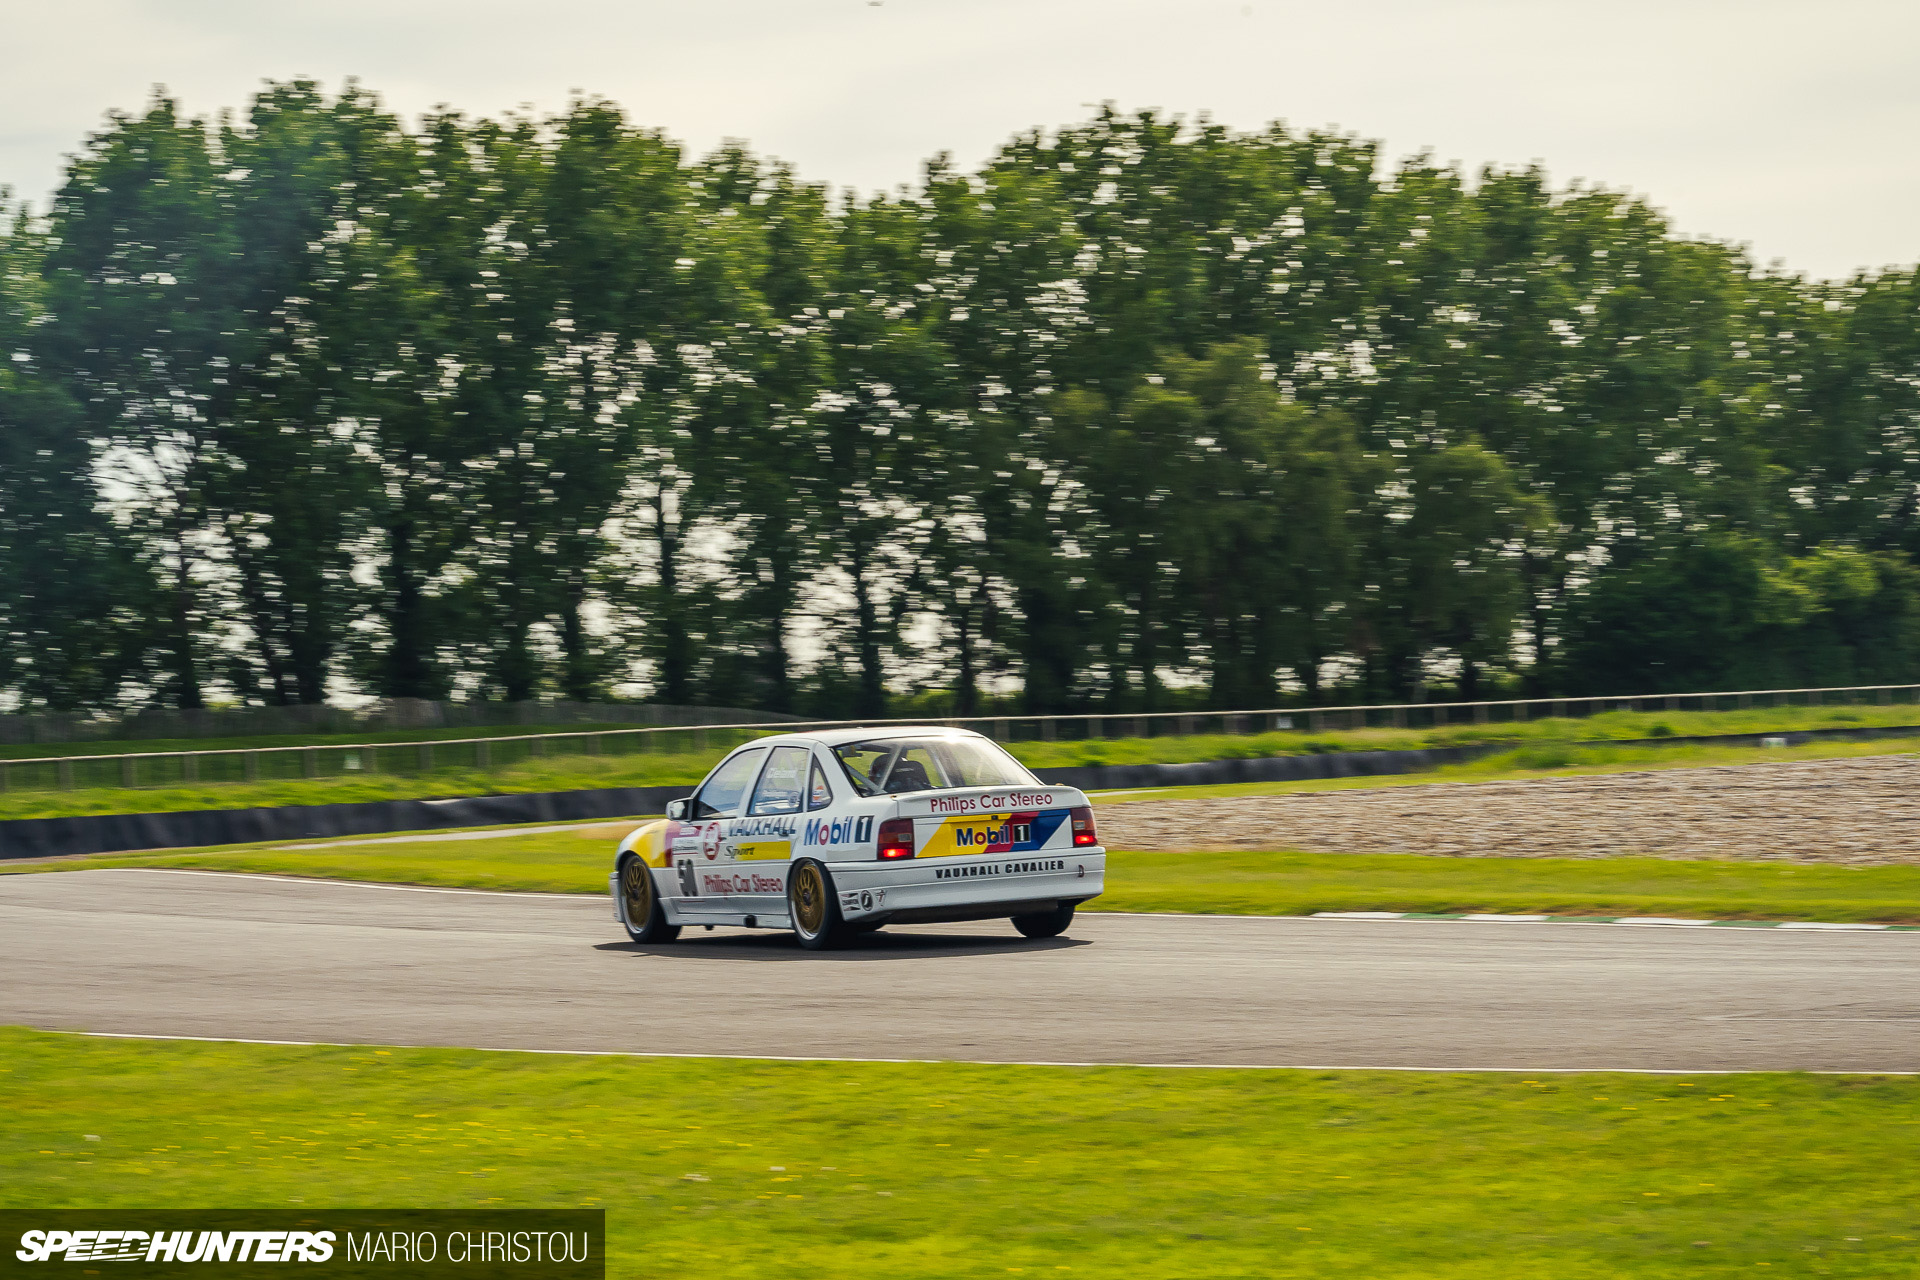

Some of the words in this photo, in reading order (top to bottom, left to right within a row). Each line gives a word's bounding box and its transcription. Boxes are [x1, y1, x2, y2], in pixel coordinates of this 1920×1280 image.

[930, 796, 976, 813] Philips
[980, 794, 1006, 809] Car
[1010, 792, 1053, 807] Stereo
[728, 816, 797, 837] VAUXHALL
[804, 816, 854, 846] Mobil
[858, 815, 872, 843] 1
[956, 825, 1010, 847] Mobil
[1015, 824, 1029, 842] 1
[724, 845, 755, 859] Sport
[935, 863, 1001, 879] VAUXHALL
[1004, 860, 1065, 874] CAVALIER
[703, 874, 733, 896] Philips
[733, 874, 751, 892] Car
[751, 873, 784, 892] Stereo
